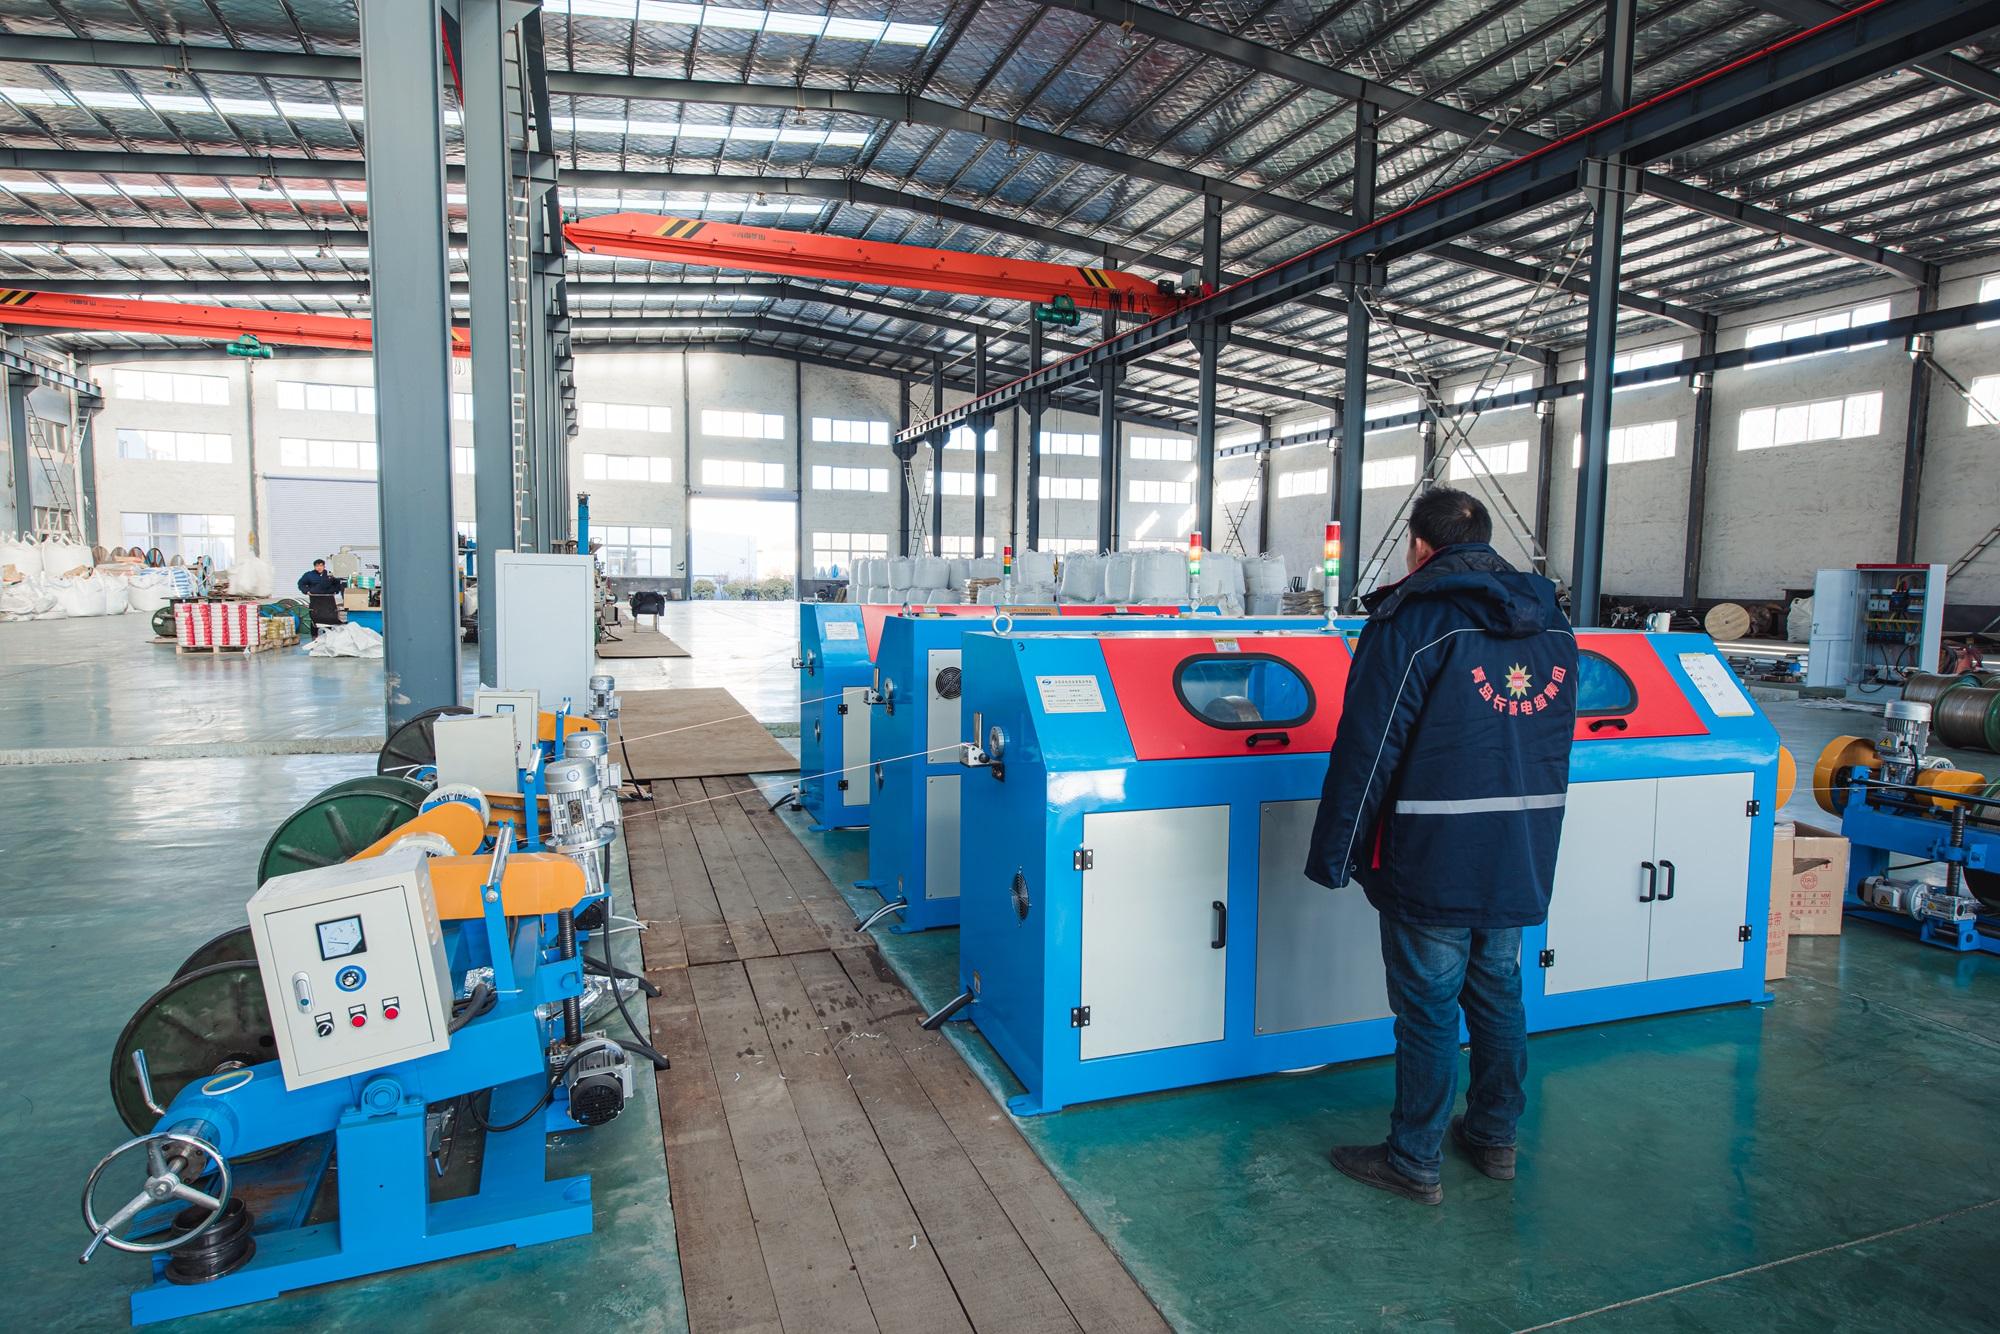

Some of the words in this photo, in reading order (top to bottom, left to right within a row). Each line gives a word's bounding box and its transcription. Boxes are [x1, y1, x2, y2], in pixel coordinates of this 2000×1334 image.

[1471, 665, 1567, 717] 青岛长城电缆集团
